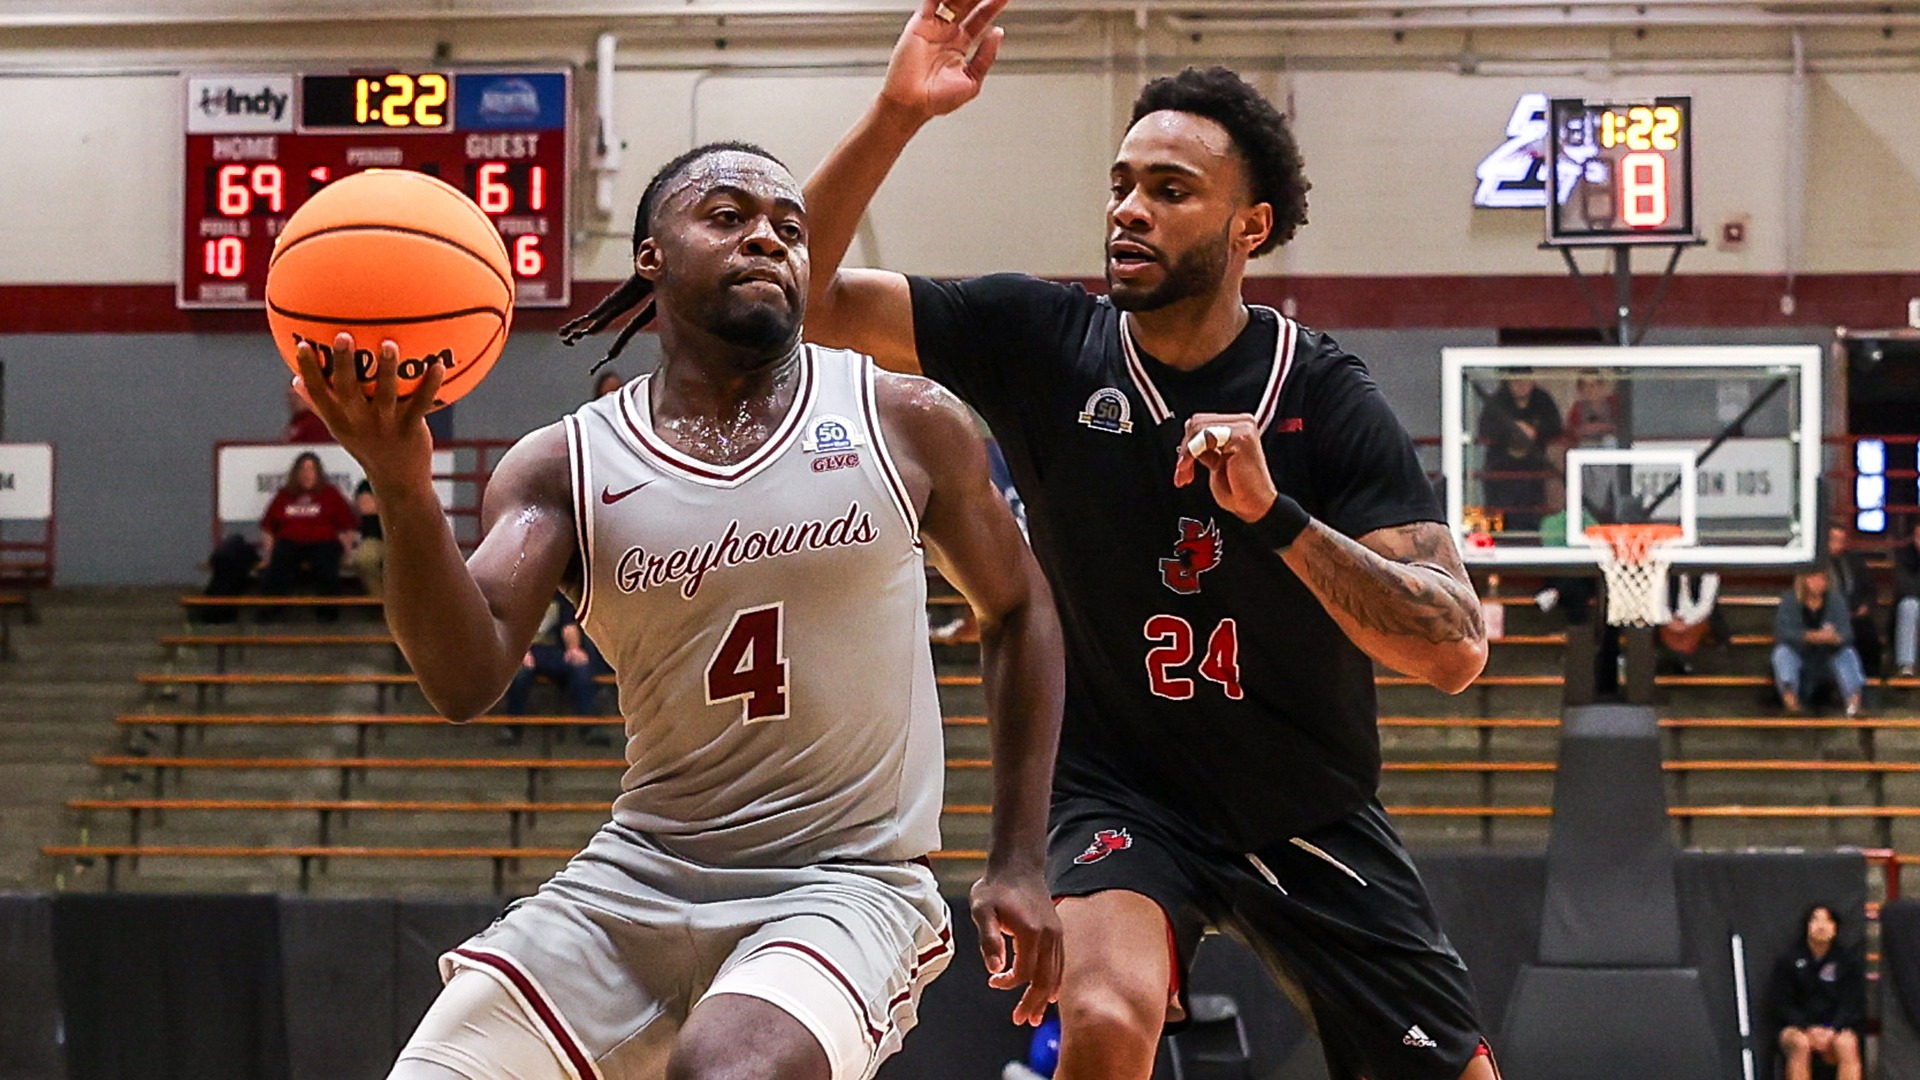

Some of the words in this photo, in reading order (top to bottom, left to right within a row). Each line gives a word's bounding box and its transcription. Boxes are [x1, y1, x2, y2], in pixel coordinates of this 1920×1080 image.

[226, 86, 288, 121] Indy
[355, 74, 447, 127] 1:22
[466, 133, 539, 159] GUEST
[1601, 106, 1680, 151] 1:22
[218, 164, 284, 216] 69
[477, 162, 546, 214] 61
[1620, 151, 1667, 227] 8
[204, 236, 245, 278] 10
[514, 234, 545, 277] 6
[1097, 401, 1120, 420] 50
[818, 426, 845, 442] 50
[811, 453, 860, 473] GLVC
[1736, 470, 1772, 496] 105
[615, 500, 879, 601] Greyhounds
[704, 600, 790, 726] 4
[1143, 614, 1244, 700] 24
